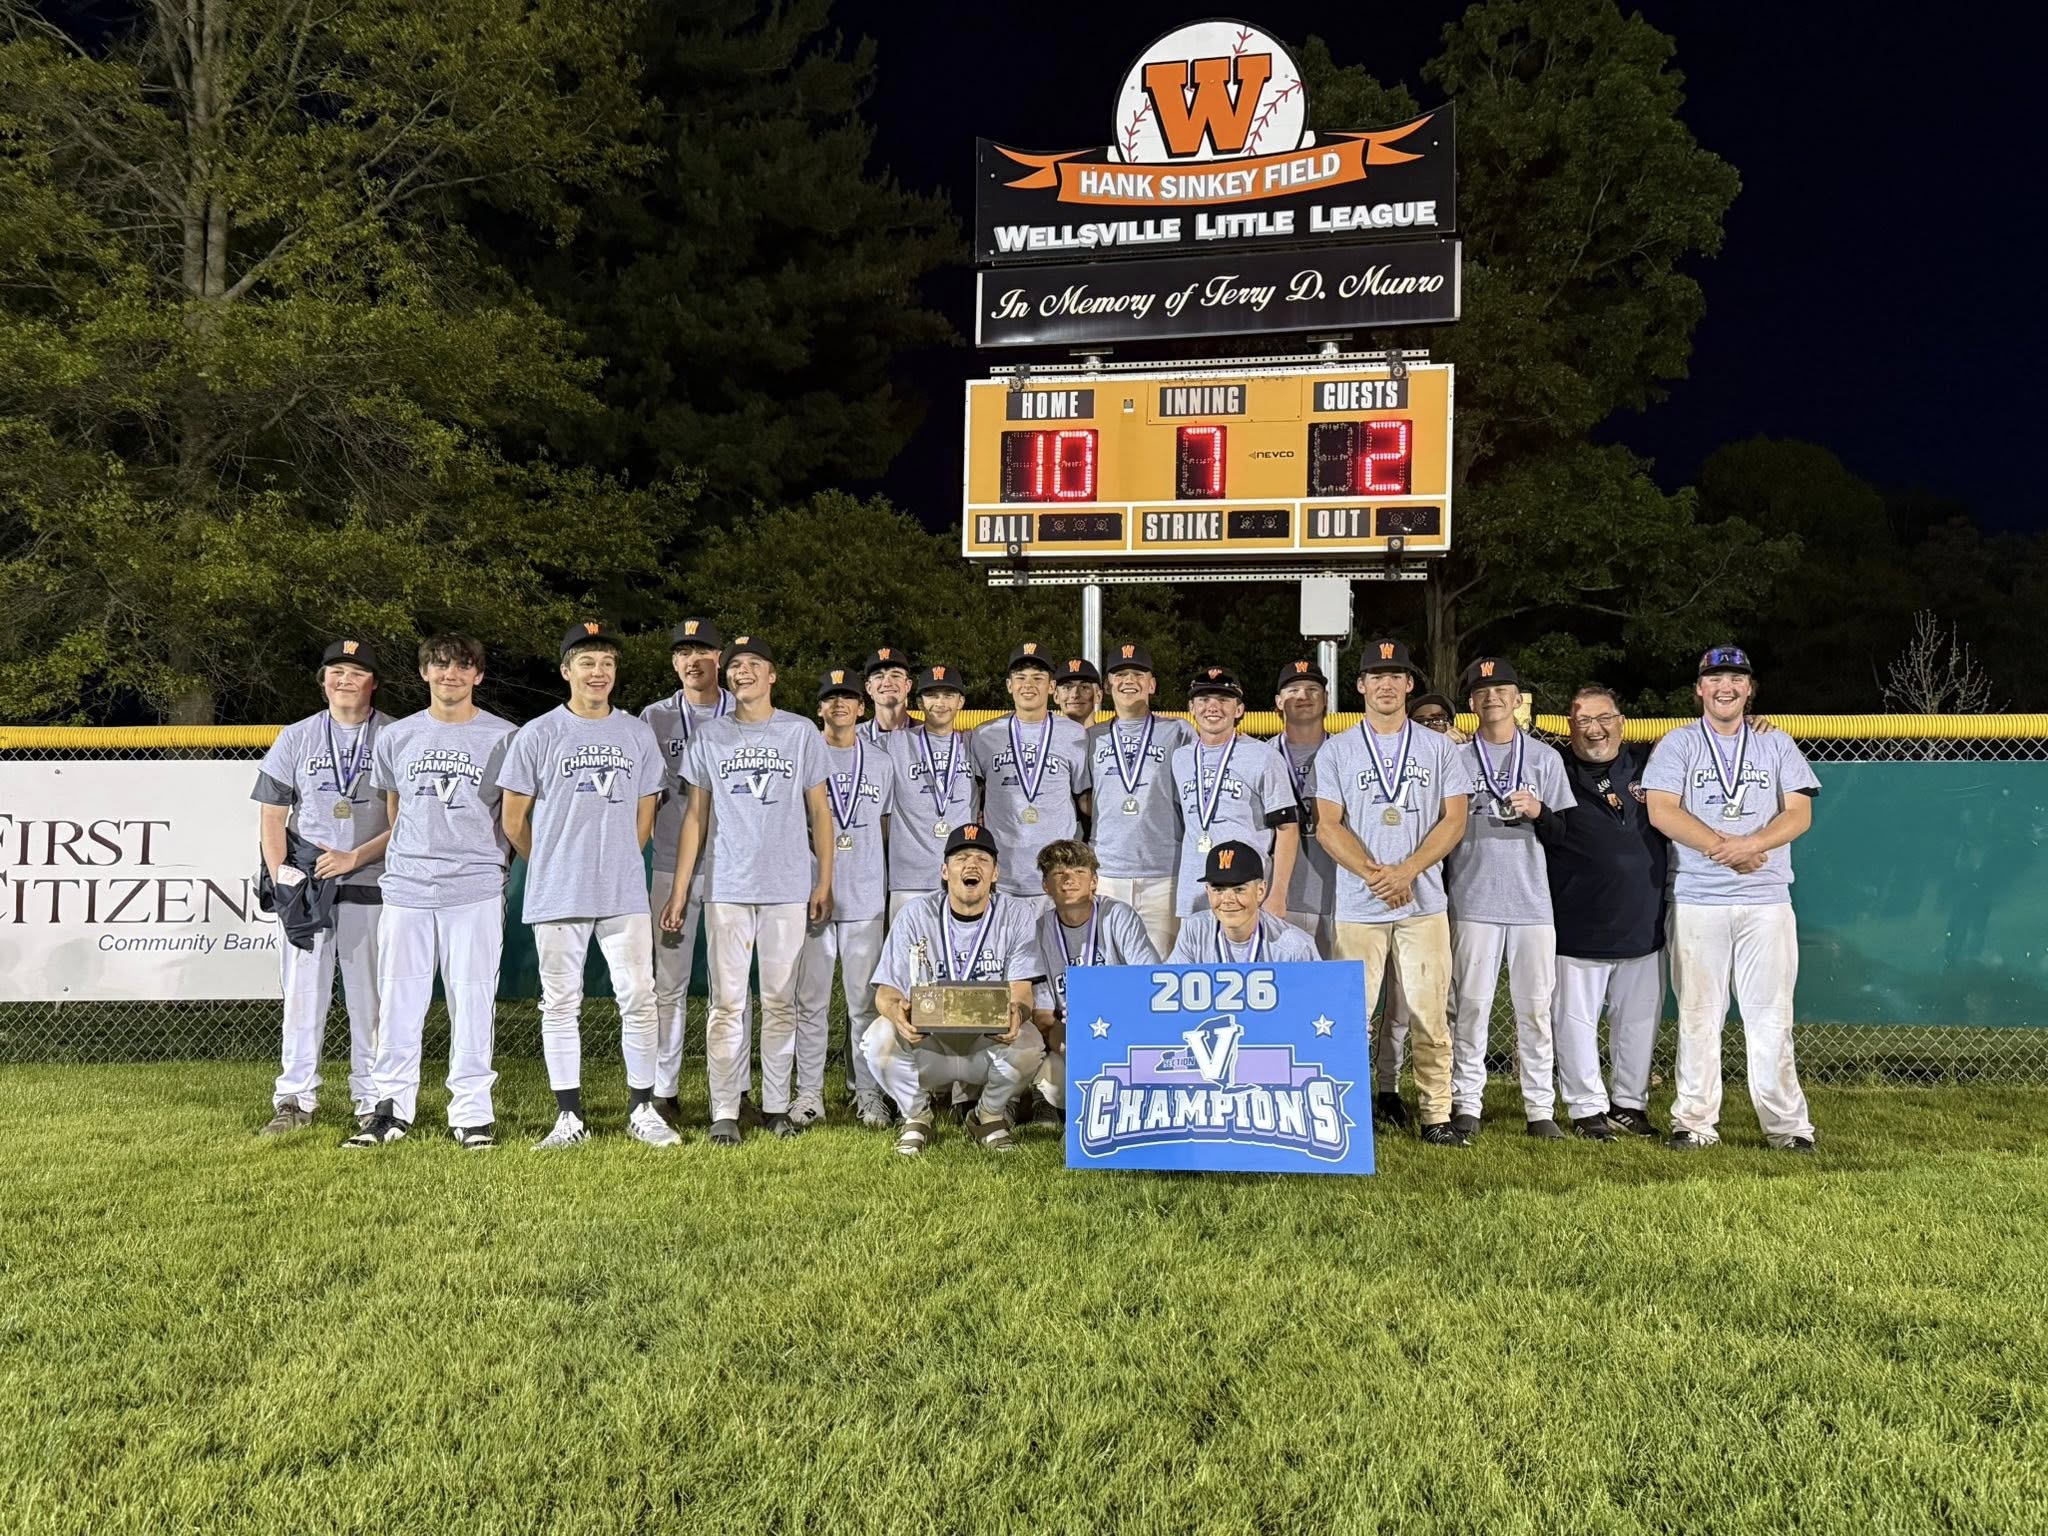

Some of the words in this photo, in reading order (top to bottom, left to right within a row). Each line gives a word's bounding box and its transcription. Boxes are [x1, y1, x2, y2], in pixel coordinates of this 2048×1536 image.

[1142, 52, 1272, 159] W
[1080, 168, 1154, 198] HANK
[1160, 168, 1259, 199] SINKEY
[1264, 152, 1341, 191] FIELD
[994, 218, 1181, 252] WELLSVILLE
[1196, 210, 1295, 240] LITTLE
[1310, 200, 1436, 233] LEAGUE
[991, 288, 1031, 319] In
[1039, 284, 1155, 320] Memory
[1165, 283, 1199, 317] of
[1200, 275, 1276, 312] Terry
[1285, 269, 1326, 301] D.
[1338, 264, 1445, 298] Munro
[1021, 391, 1079, 419] HOME
[1166, 386, 1240, 415] INNING
[1323, 381, 1398, 410] GUESTS
[1036, 431, 1093, 498] 10
[1185, 426, 1221, 492] 7
[1365, 421, 1406, 492] 2
[979, 515, 1030, 543] BALL
[1146, 512, 1219, 541] STRIKE
[1317, 509, 1361, 537] OUT
[583, 621, 600, 635] W
[684, 620, 699, 635] W
[877, 648, 891, 661] W
[1023, 642, 1037, 656] W
[1121, 644, 1135, 659] W
[1379, 642, 1395, 660] W
[830, 669, 845, 685] W
[932, 665, 946, 681] W
[1068, 659, 1082, 673] W
[1294, 661, 1309, 673] W
[1480, 661, 1495, 677] W
[424, 749, 470, 763] 2026
[577, 744, 622, 757] 2026
[734, 747, 779, 759] 2026
[407, 759, 484, 786] CHAMPIONS
[719, 757, 793, 779] CHAMPIONS
[964, 825, 979, 840] W
[1218, 850, 1235, 870] W
[0, 870, 277, 924] ITIZEN
[98, 934, 217, 955] Community
[224, 933, 277, 950] Bank
[1151, 968, 1278, 1012] 2026
[1163, 1056, 1195, 1068] SECTION
[1183, 1024, 1244, 1080] V
[1087, 1080, 1341, 1144] CHAMPIONS
